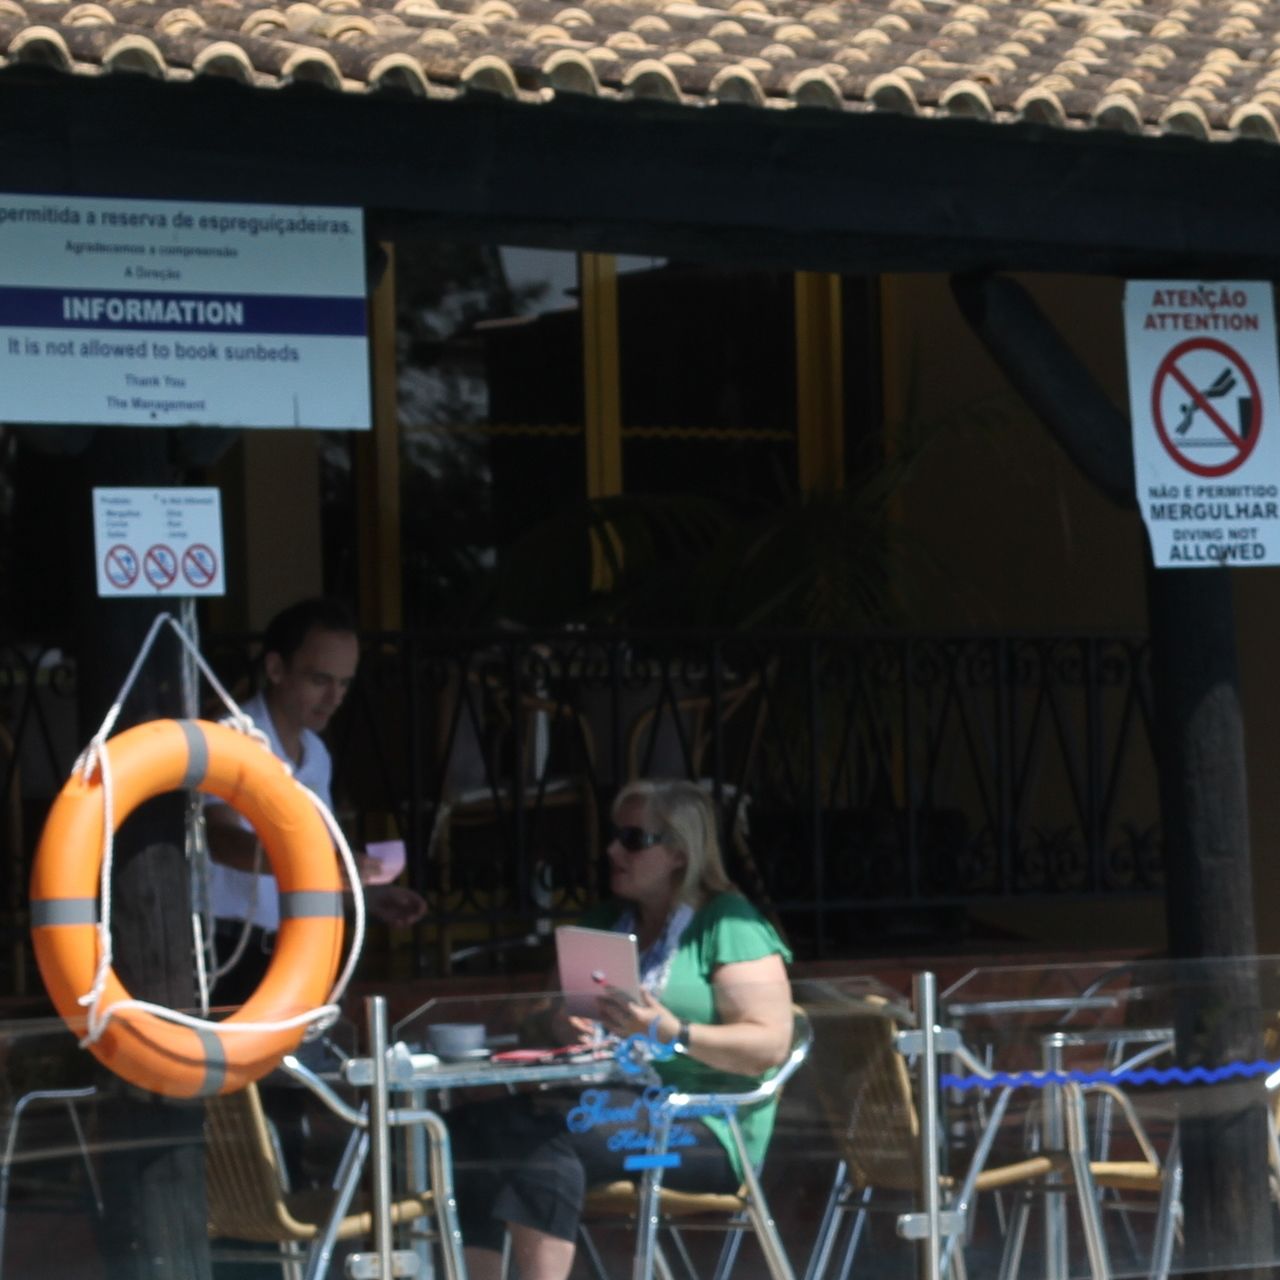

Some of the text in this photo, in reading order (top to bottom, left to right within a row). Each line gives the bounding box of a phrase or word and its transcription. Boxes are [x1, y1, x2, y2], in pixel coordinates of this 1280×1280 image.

[0, 206, 80, 224] permitida
[86, 211, 96, 226] a
[102, 211, 166, 228] reserva
[172, 210, 194, 229] de
[1152, 286, 1248, 312] ATENÇÃO
[62, 296, 244, 326] INFORMATION
[1143, 311, 1260, 331] ATTENTION
[8, 337, 299, 362] It is not allowed to book sunbeds
[125, 373, 186, 389] Thank You
[107, 395, 206, 413] The Management
[1148, 482, 1179, 499] NÃO
[1197, 485, 1278, 499] PERMITIDO
[1150, 502, 1279, 521] MERGULHAR
[1173, 527, 1258, 541] DIVING NOT
[1170, 543, 1266, 561] ALLOWED
